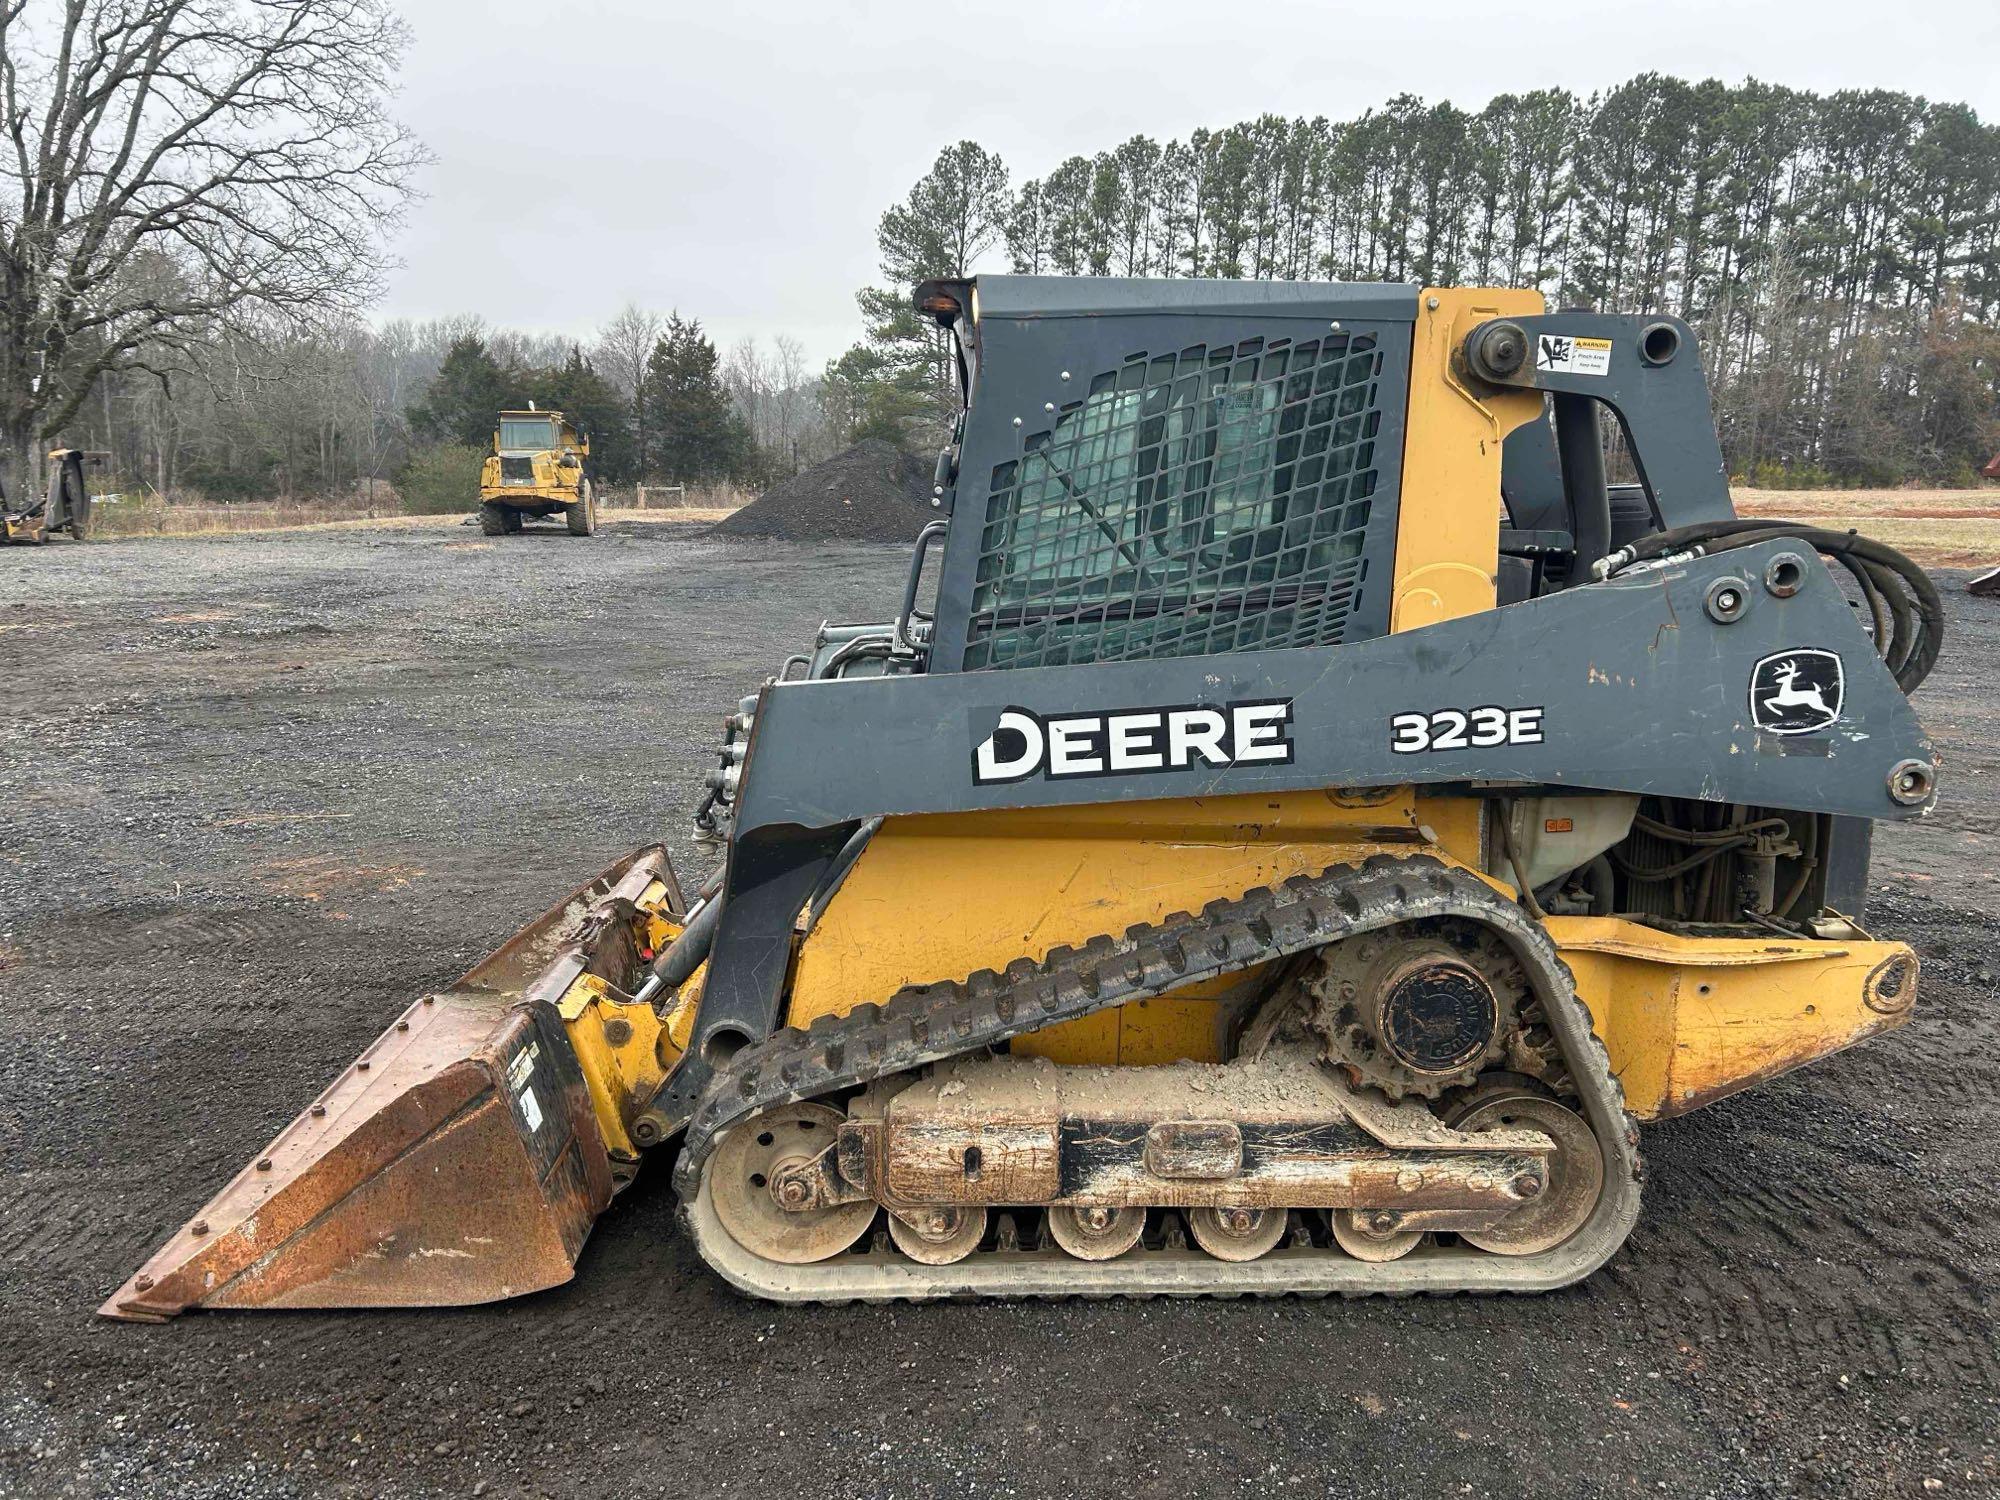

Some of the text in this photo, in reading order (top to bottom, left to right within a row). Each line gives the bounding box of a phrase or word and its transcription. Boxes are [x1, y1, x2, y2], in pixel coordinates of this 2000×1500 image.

[1582, 341, 1609, 349] WARNING
[977, 703, 1288, 780] DEERE
[1393, 708, 1542, 752] 323E
